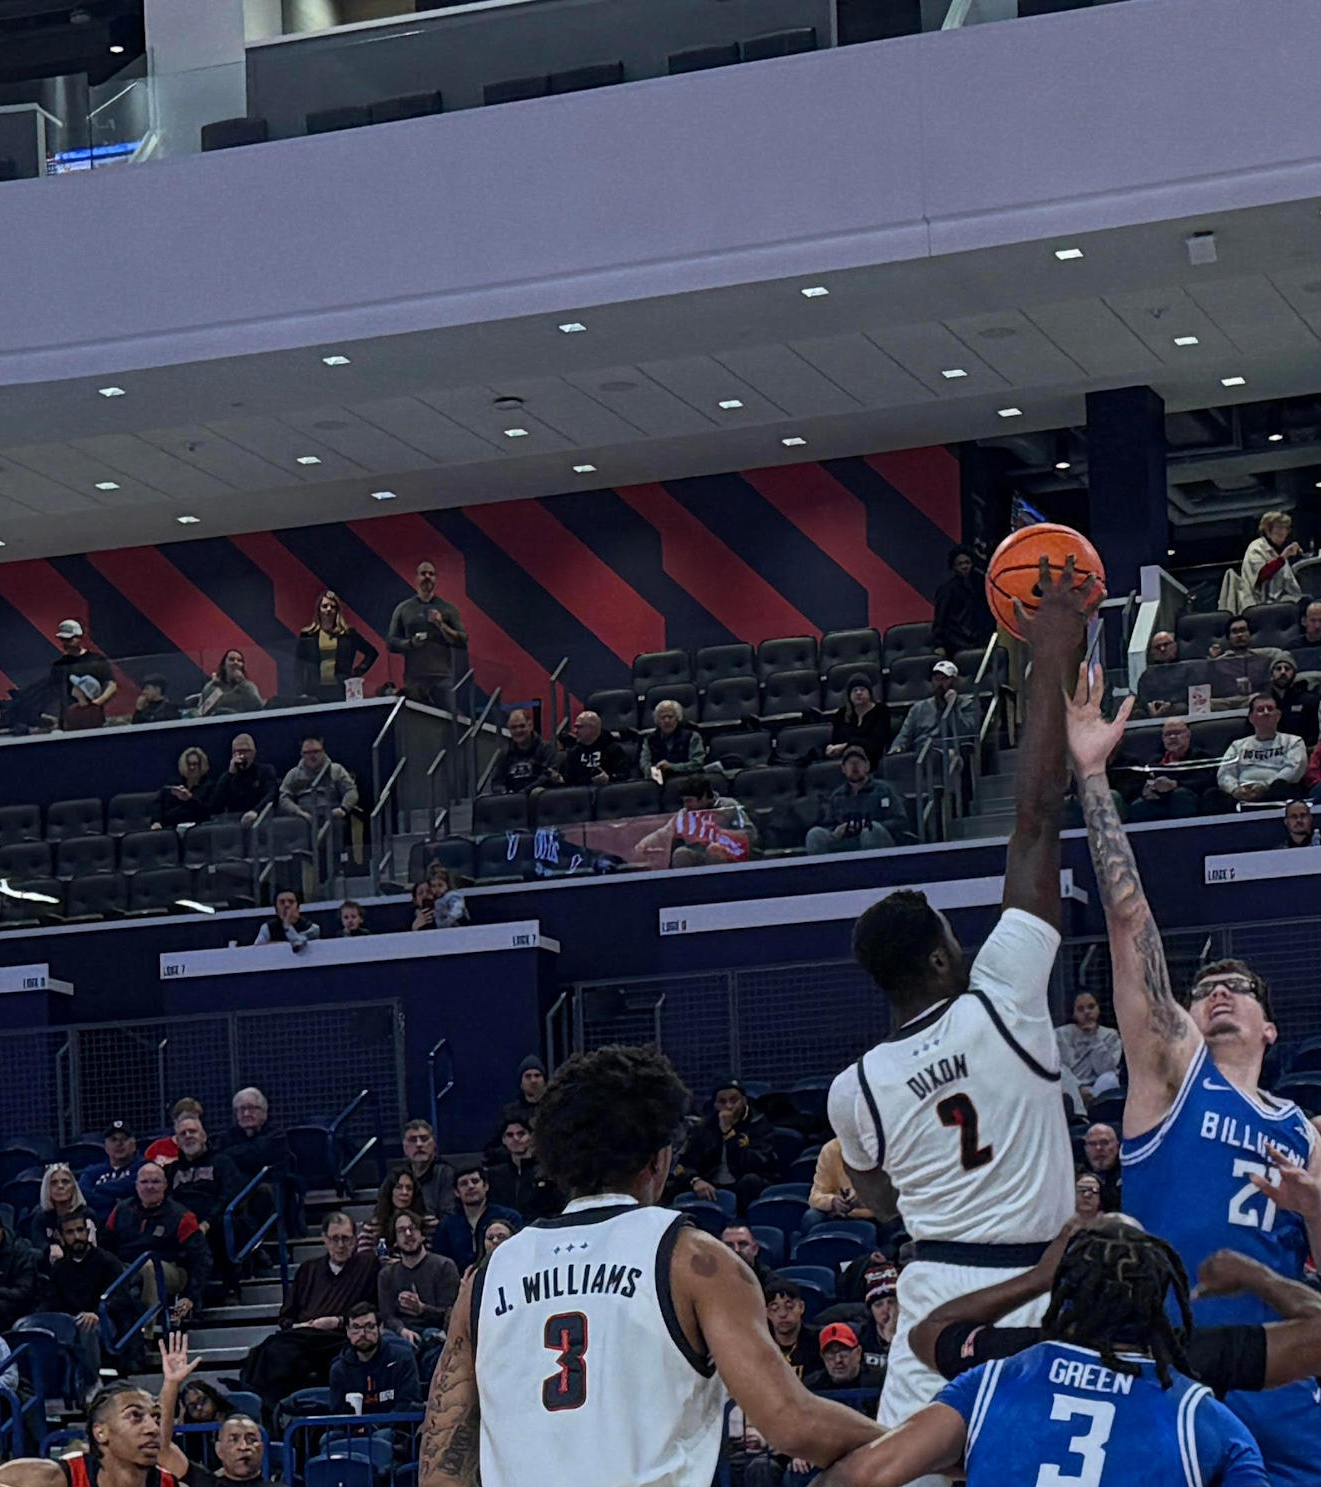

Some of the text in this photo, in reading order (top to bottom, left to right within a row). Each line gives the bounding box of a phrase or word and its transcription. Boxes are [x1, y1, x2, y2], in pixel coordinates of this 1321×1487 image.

[906, 1054, 968, 1100] DIXON
[936, 1093, 993, 1171] 2
[1229, 1158, 1284, 1232] 21
[495, 1263, 642, 1316] J. WILLIAMS
[542, 1311, 588, 1412] 3
[1048, 1358, 1134, 1395] GREEN
